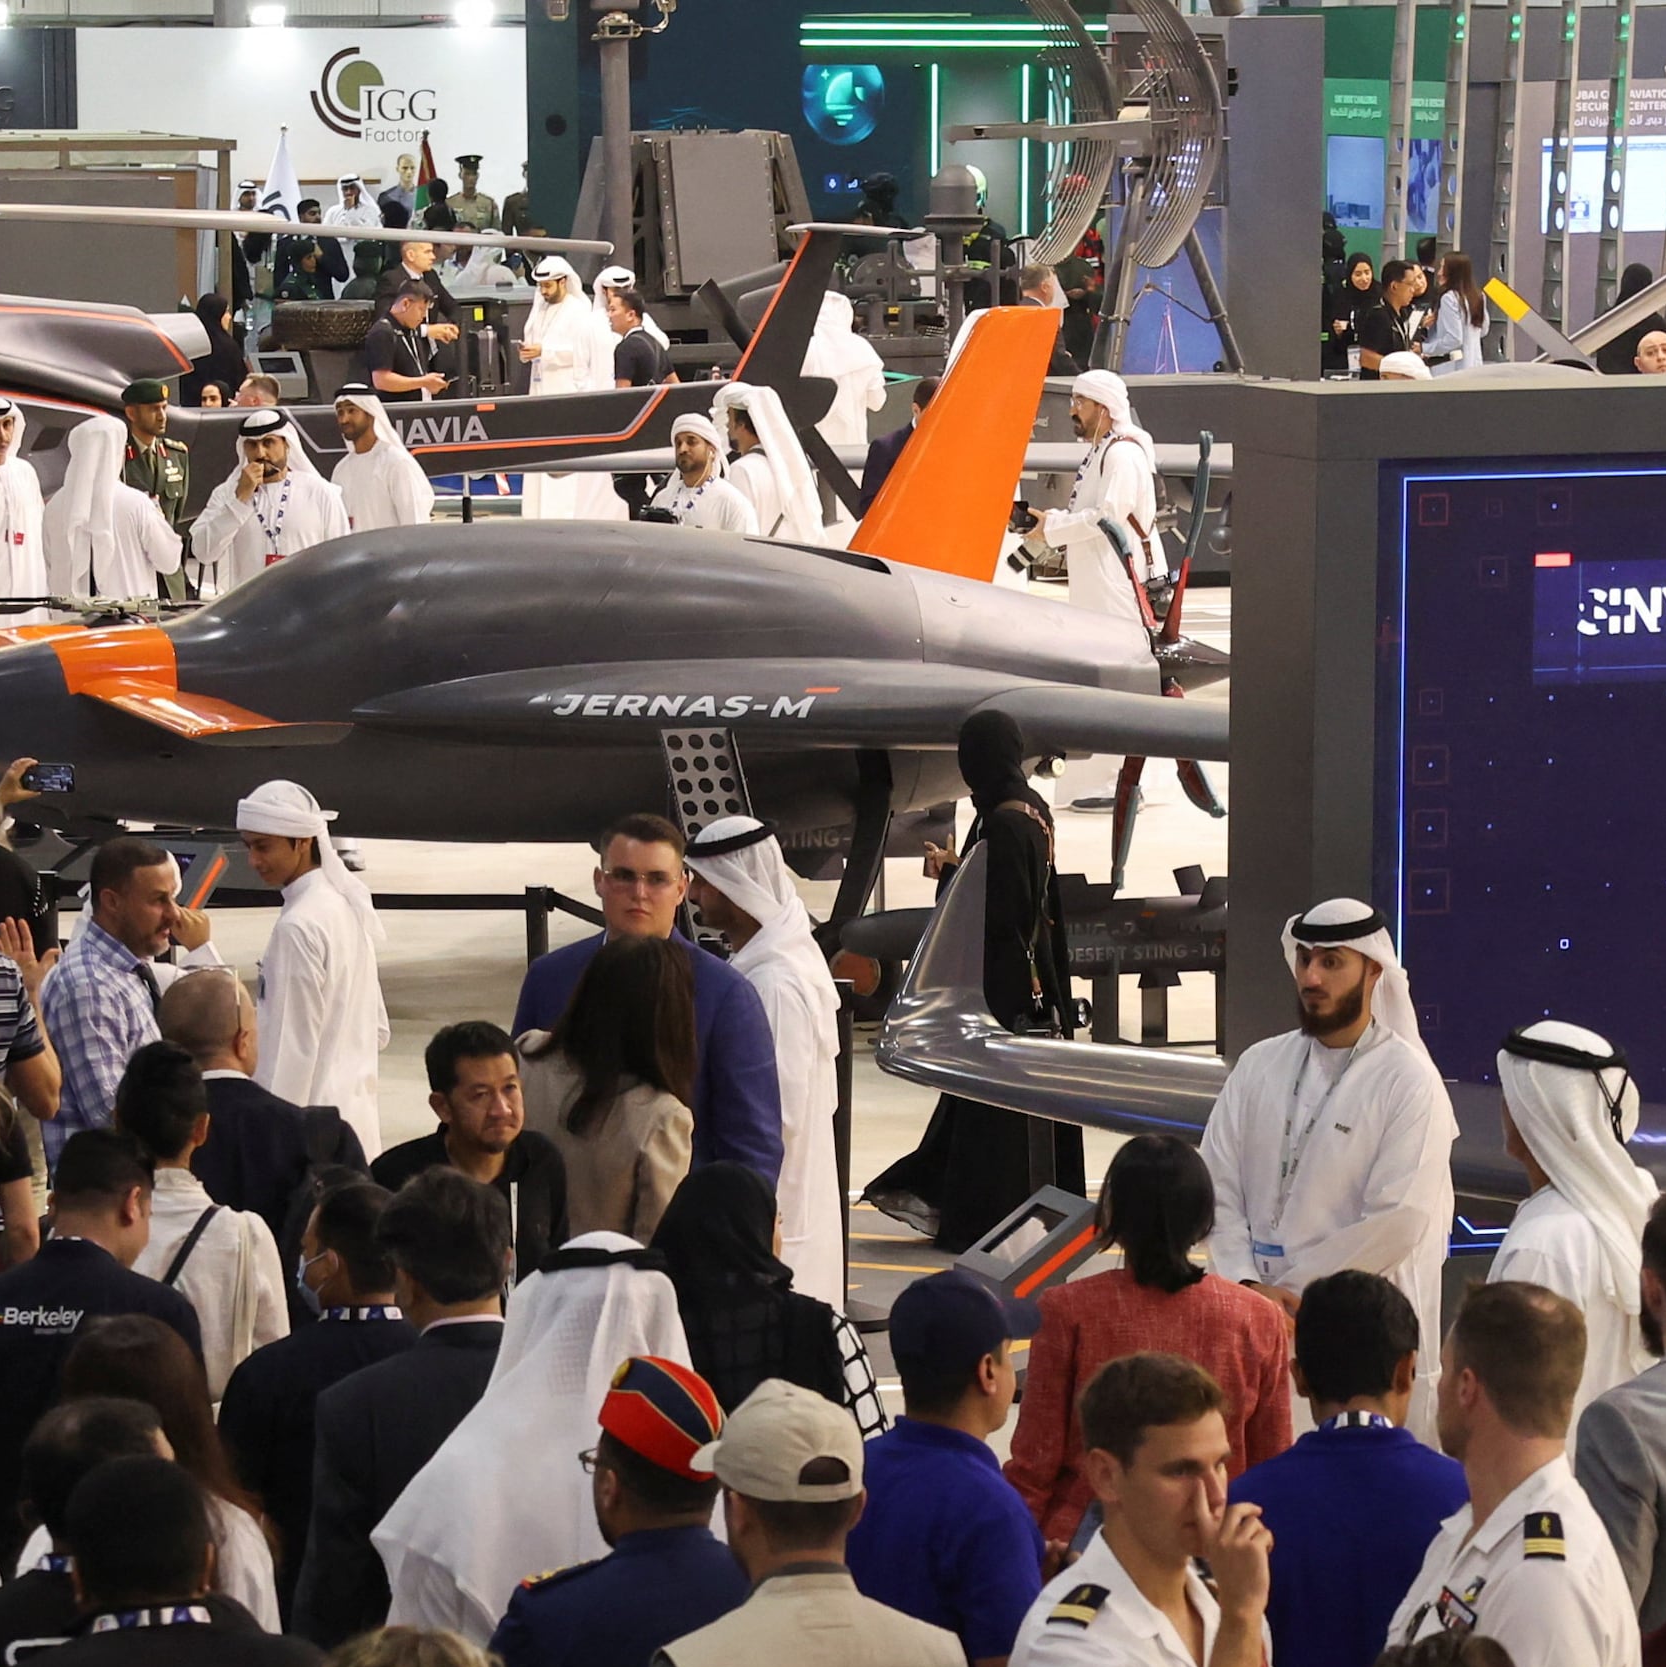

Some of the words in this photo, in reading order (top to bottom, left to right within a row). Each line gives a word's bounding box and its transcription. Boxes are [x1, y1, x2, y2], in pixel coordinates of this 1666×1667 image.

[364, 89, 437, 121] IGG
[552, 694, 817, 719] JERNAS-M
[3, 1305, 84, 1333] Berkeley
